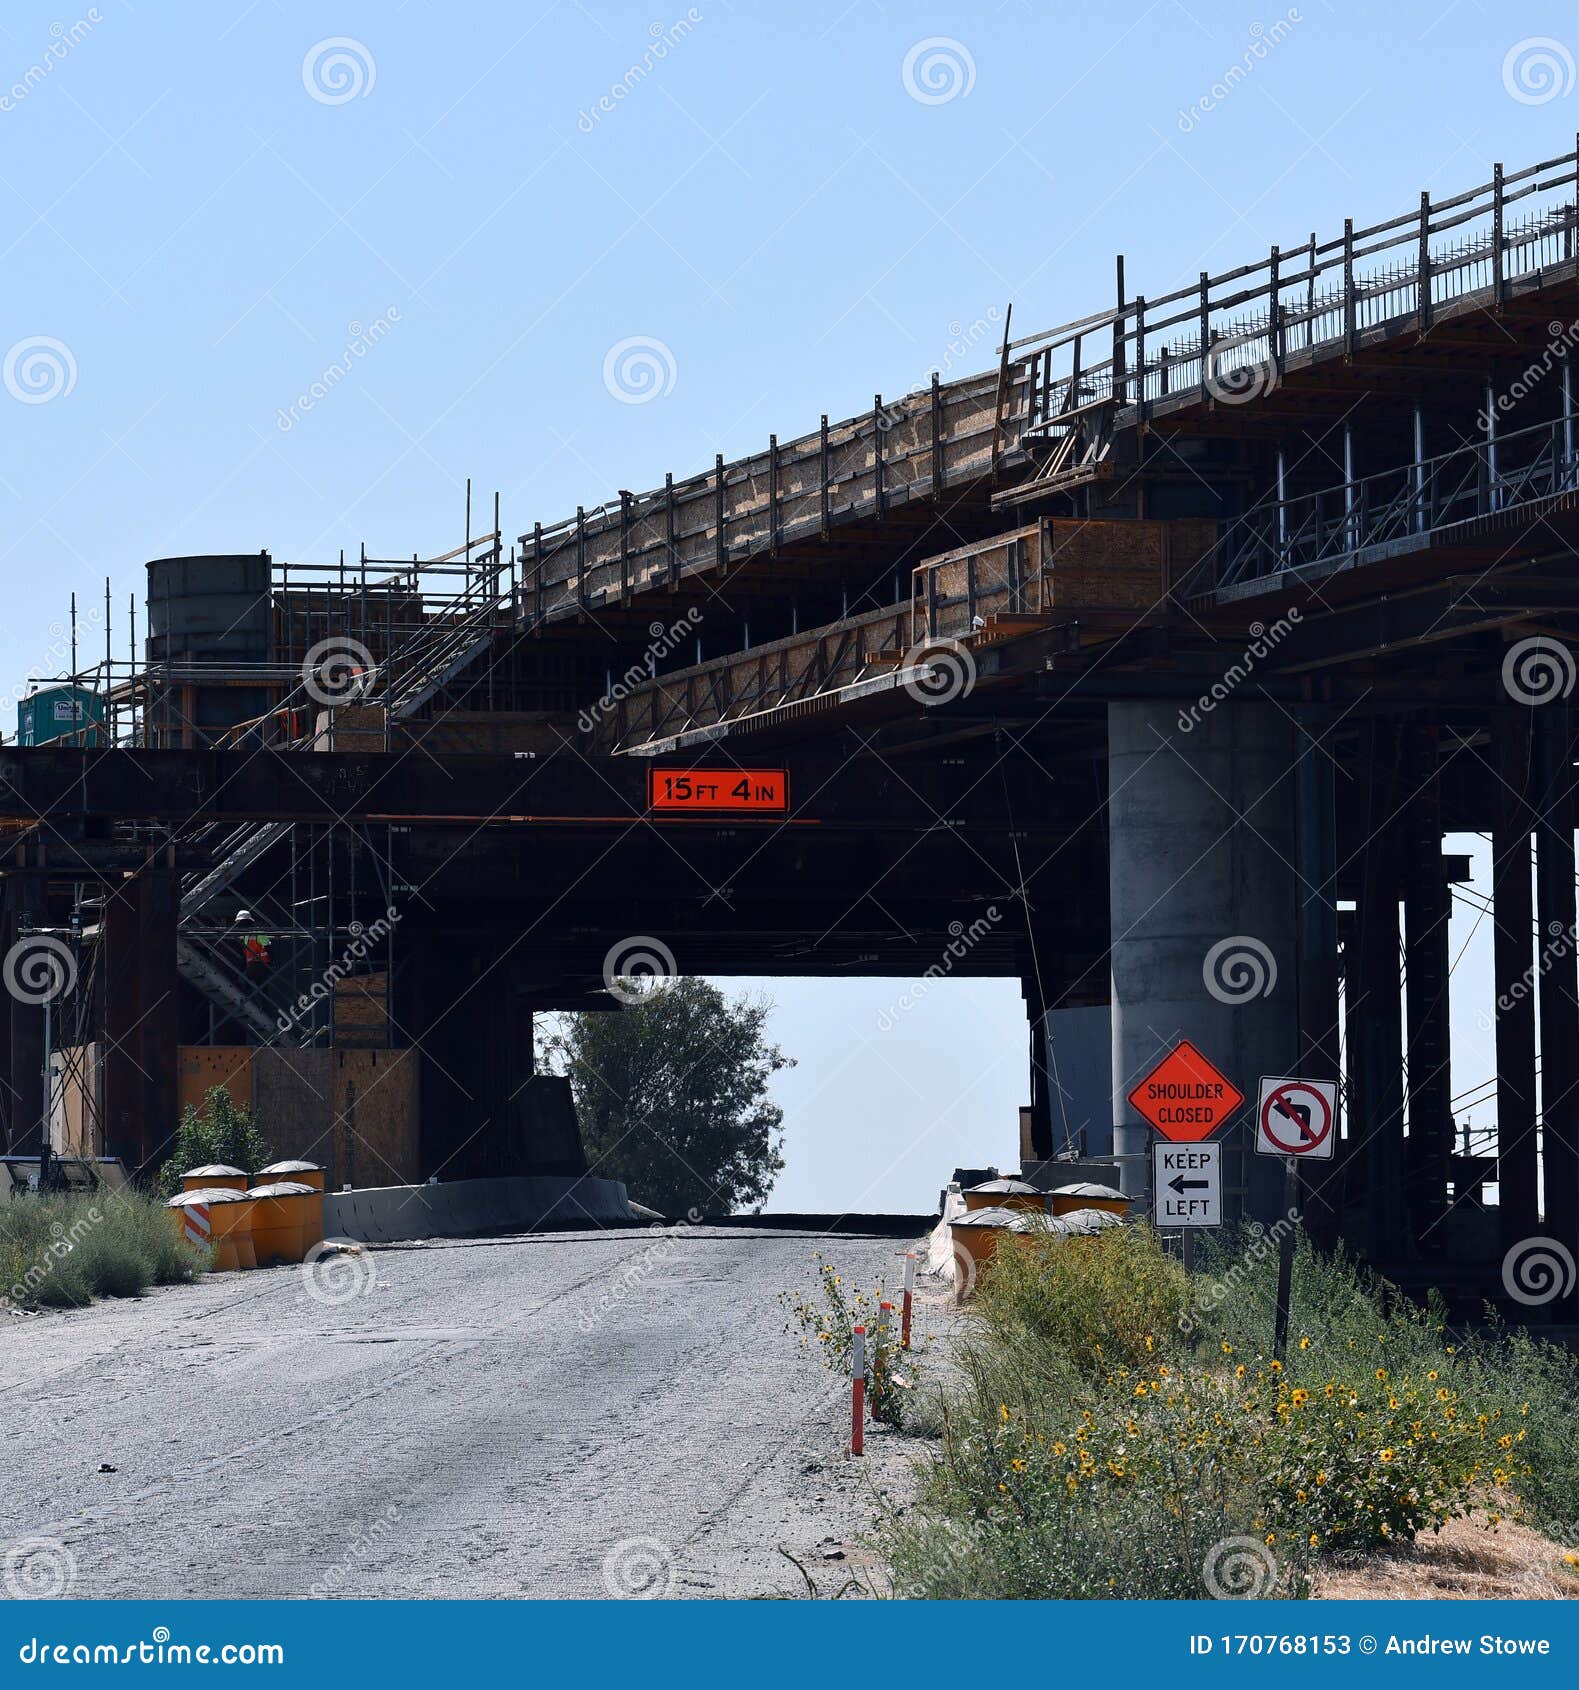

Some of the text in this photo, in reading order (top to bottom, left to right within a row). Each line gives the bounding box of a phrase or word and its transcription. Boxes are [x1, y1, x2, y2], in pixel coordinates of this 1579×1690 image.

[1147, 1083, 1224, 1100] SHOULDER
[1158, 1107, 1214, 1123] CLOSED
[1164, 1153, 1211, 1169] KEEP
[1165, 1200, 1210, 1216] LEFT
